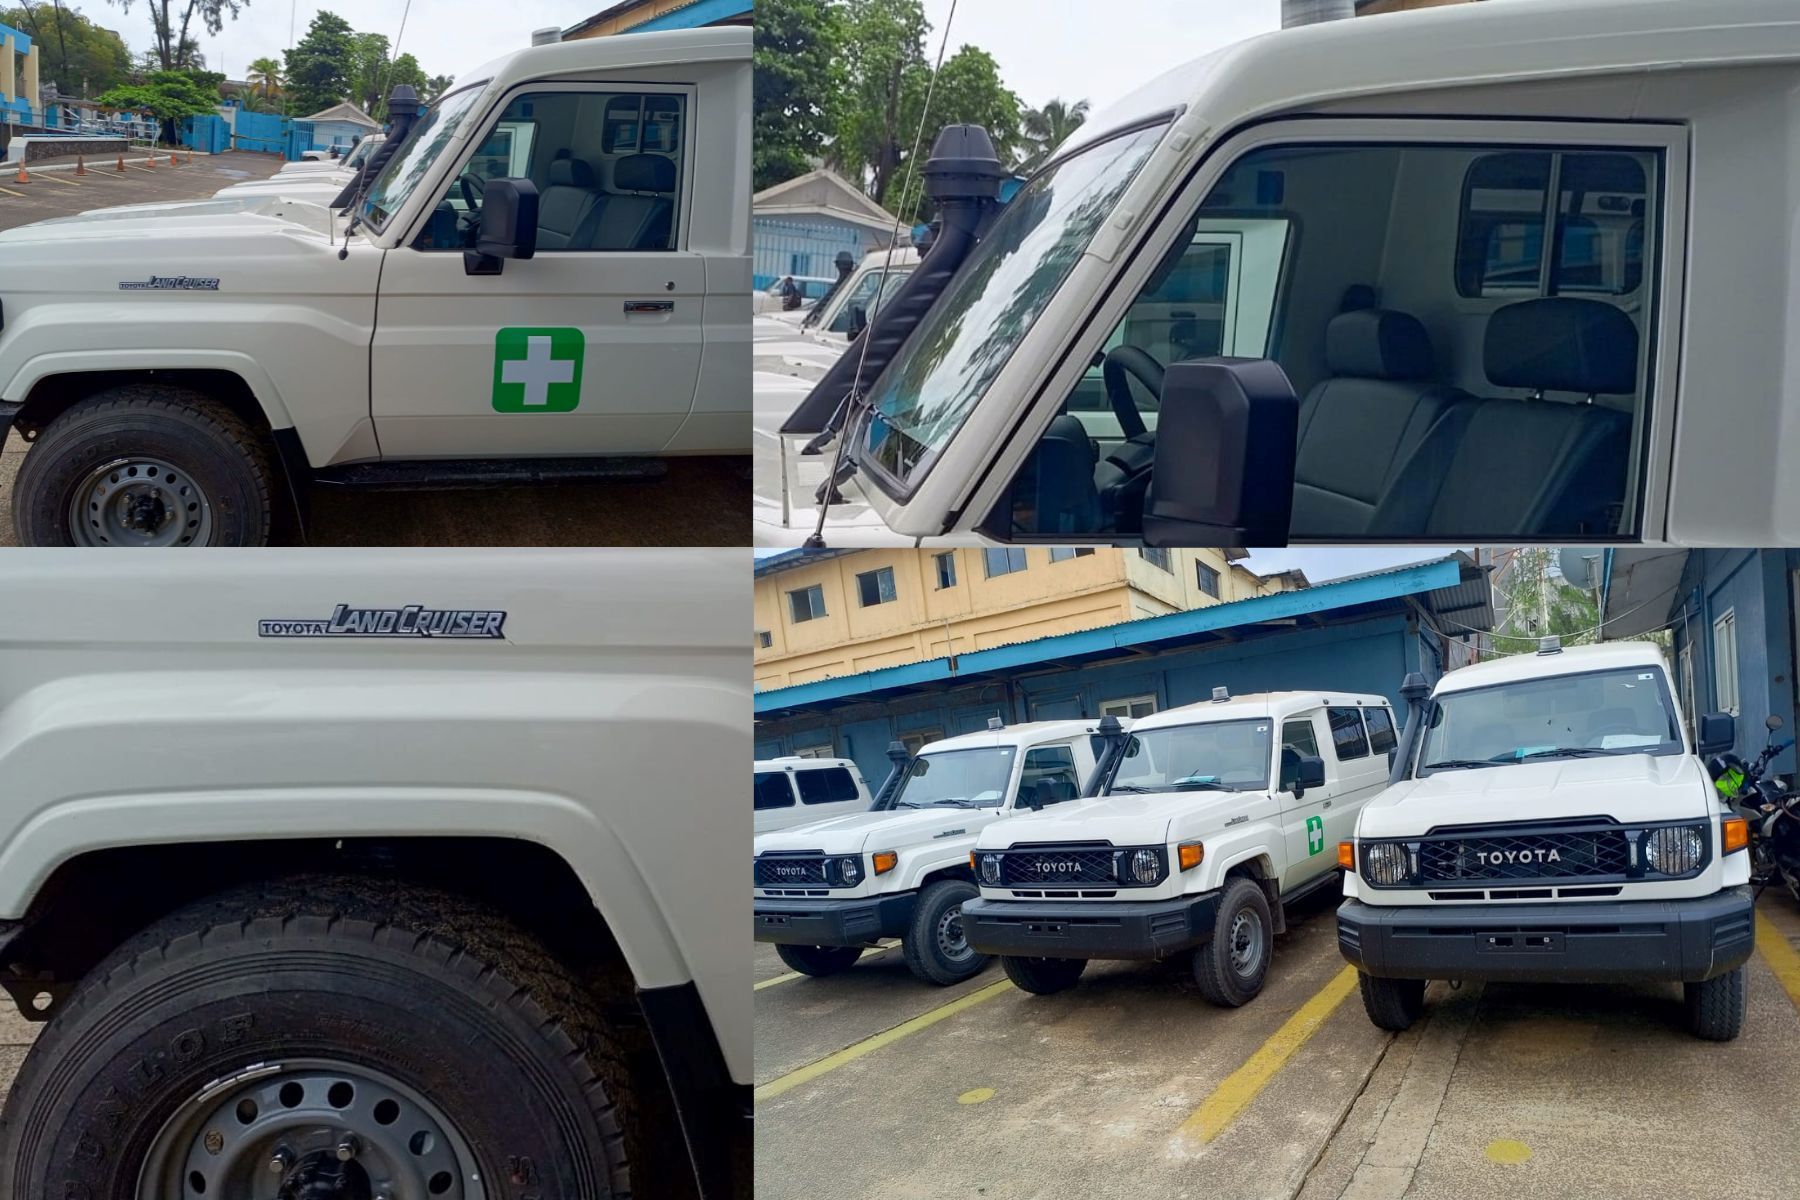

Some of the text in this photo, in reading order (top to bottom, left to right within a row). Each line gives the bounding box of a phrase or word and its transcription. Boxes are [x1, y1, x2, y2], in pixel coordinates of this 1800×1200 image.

[262, 622, 323, 635] TOYOTA
[1477, 848, 1561, 865] TOYOTA
[776, 867, 807, 876] TOYOTA
[1035, 862, 1082, 873] TOYOTA
